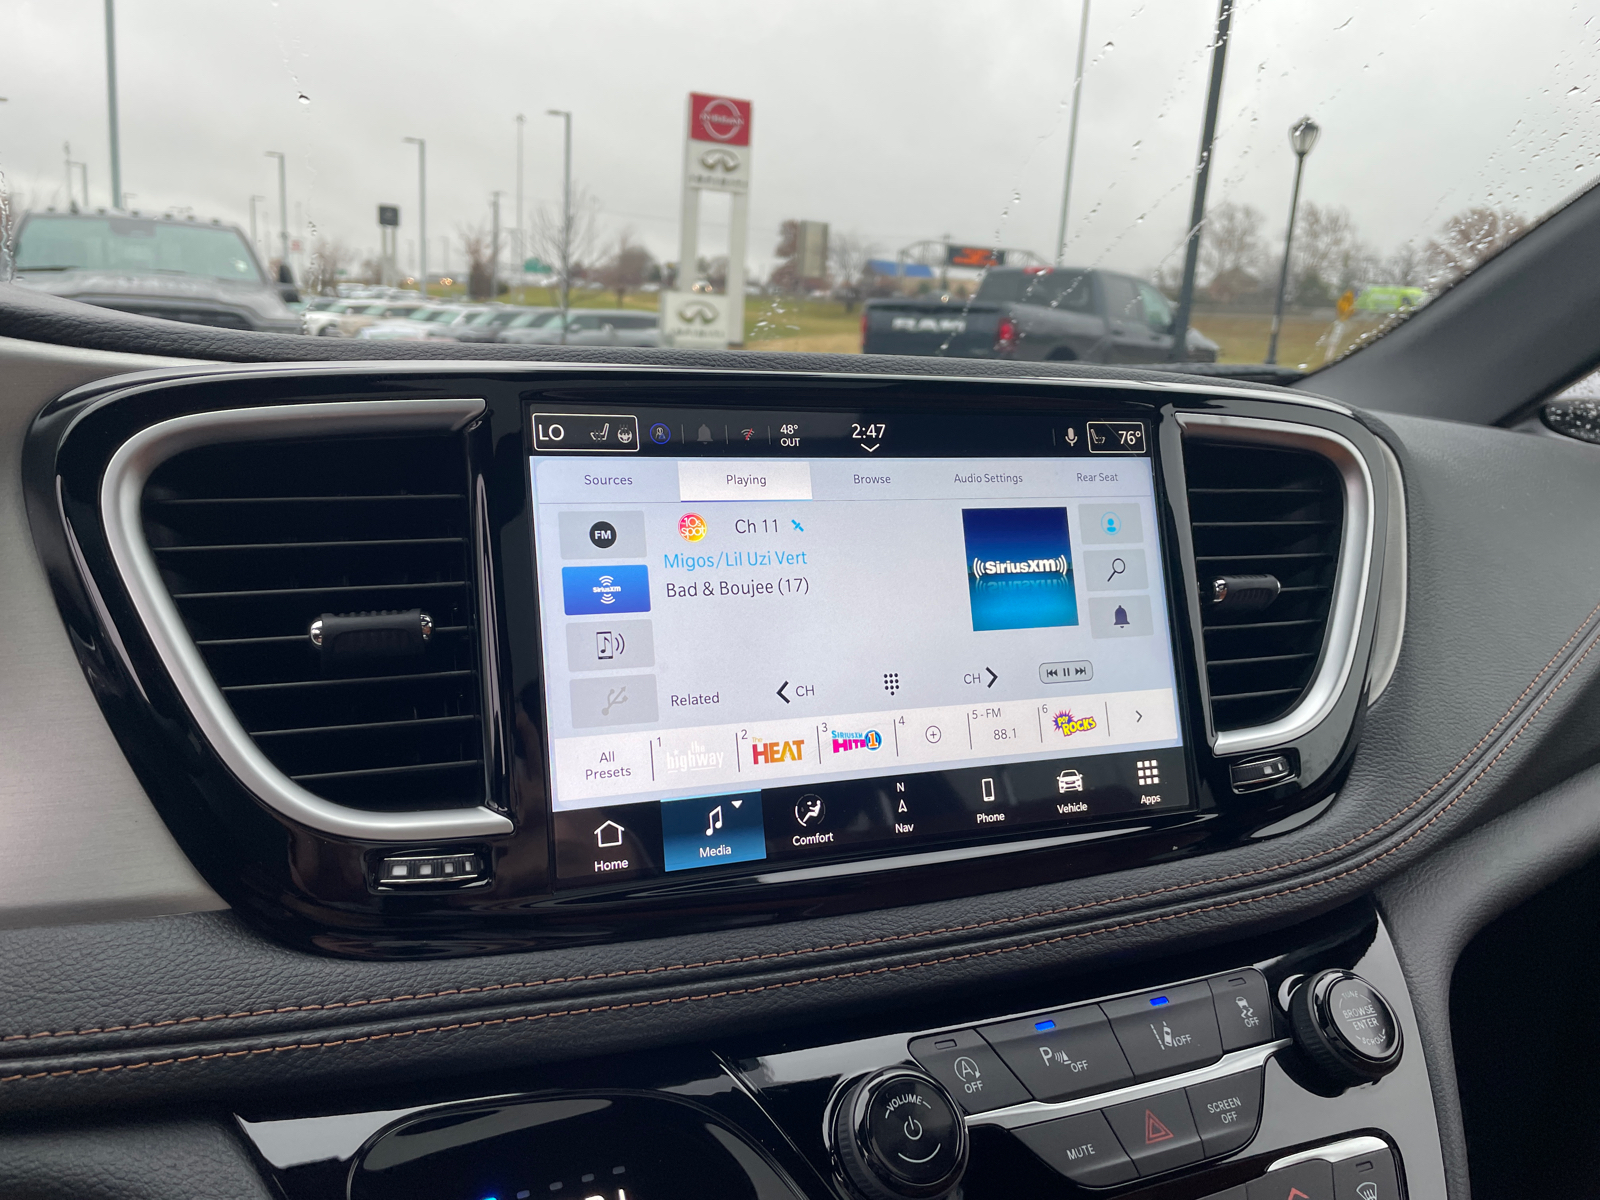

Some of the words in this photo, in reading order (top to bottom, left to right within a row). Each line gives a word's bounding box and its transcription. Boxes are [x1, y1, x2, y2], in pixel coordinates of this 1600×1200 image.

[538, 424, 564, 441] LO
[780, 424, 798, 435] 48°
[851, 424, 886, 439] 2:47
[780, 437, 800, 447] OUT
[1118, 430, 1141, 445] 76°
[584, 474, 633, 486] Sources
[726, 474, 767, 487] Playing
[853, 474, 891, 485] Browse
[954, 473, 983, 484] Audio
[984, 473, 1023, 484] Settings
[1076, 472, 1098, 482] Rear
[1099, 472, 1118, 482] Seat
[681, 525, 706, 540] spot
[734, 518, 757, 534] Ch
[764, 519, 779, 532] 11
[594, 530, 612, 540] FM
[747, 551, 772, 566] Uzi
[775, 551, 808, 566] Vert
[666, 583, 697, 598] Bad
[703, 583, 715, 596] &
[719, 579, 774, 598] Boujee
[778, 577, 809, 595] (17)
[963, 673, 981, 685] CH
[795, 685, 815, 697] CH
[671, 692, 720, 707] Related
[1042, 704, 1048, 713] 6
[821, 722, 828, 732] 3
[898, 716, 906, 725] 4
[1062, 717, 1096, 735] ROCKS
[741, 729, 748, 740] 2
[993, 728, 1017, 740] 88.1
[657, 737, 662, 747] 1
[599, 751, 615, 763] All
[752, 740, 805, 765] HEAT
[666, 750, 724, 772] highway
[585, 767, 632, 781] Presets
[896, 782, 905, 792] N
[1141, 794, 1161, 805] Apps
[1057, 801, 1088, 813] Vehicle
[977, 812, 1005, 824] Phone
[895, 823, 914, 833] Nav
[792, 832, 834, 846] Comfort
[699, 845, 732, 858] Media
[594, 859, 629, 872] Home
[1341, 990, 1359, 999] TUNE
[1342, 1004, 1376, 1019] BROWSE
[1244, 1016, 1259, 1028] OFF
[1352, 1017, 1379, 1031] ENTER
[1176, 1034, 1192, 1046] OFF
[1361, 1033, 1386, 1046] SCROLL
[1070, 1060, 1088, 1073] OFF
[964, 1081, 983, 1094] OFF
[886, 1094, 923, 1112] VOLUME
[1207, 1097, 1242, 1114] SCREEN
[1221, 1111, 1238, 1124] OFF
[1066, 1144, 1096, 1161] MUTE
